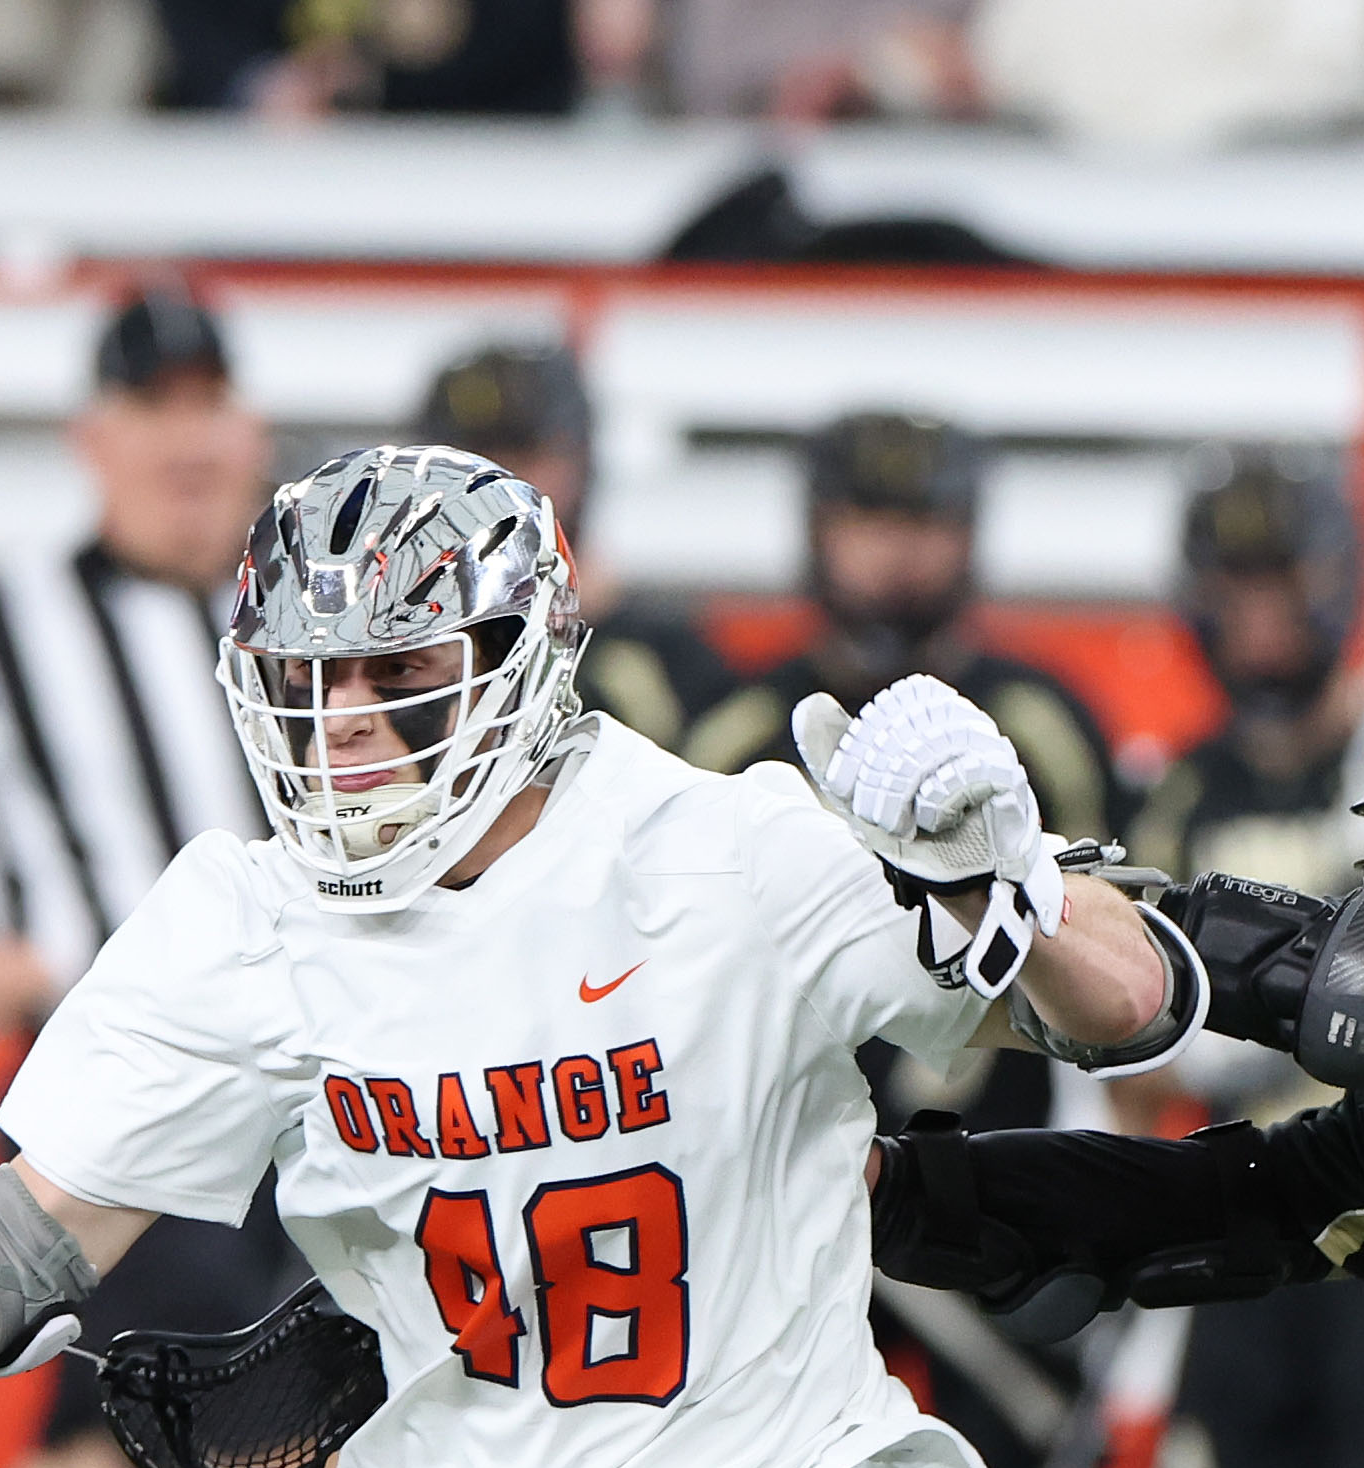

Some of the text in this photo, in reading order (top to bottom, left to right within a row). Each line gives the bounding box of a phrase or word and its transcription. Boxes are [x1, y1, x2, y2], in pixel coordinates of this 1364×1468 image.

[317, 878, 383, 897] schutt
[1223, 876, 1298, 906] integra
[323, 1037, 671, 1160] ORANGE
[414, 1161, 690, 1408] 48
